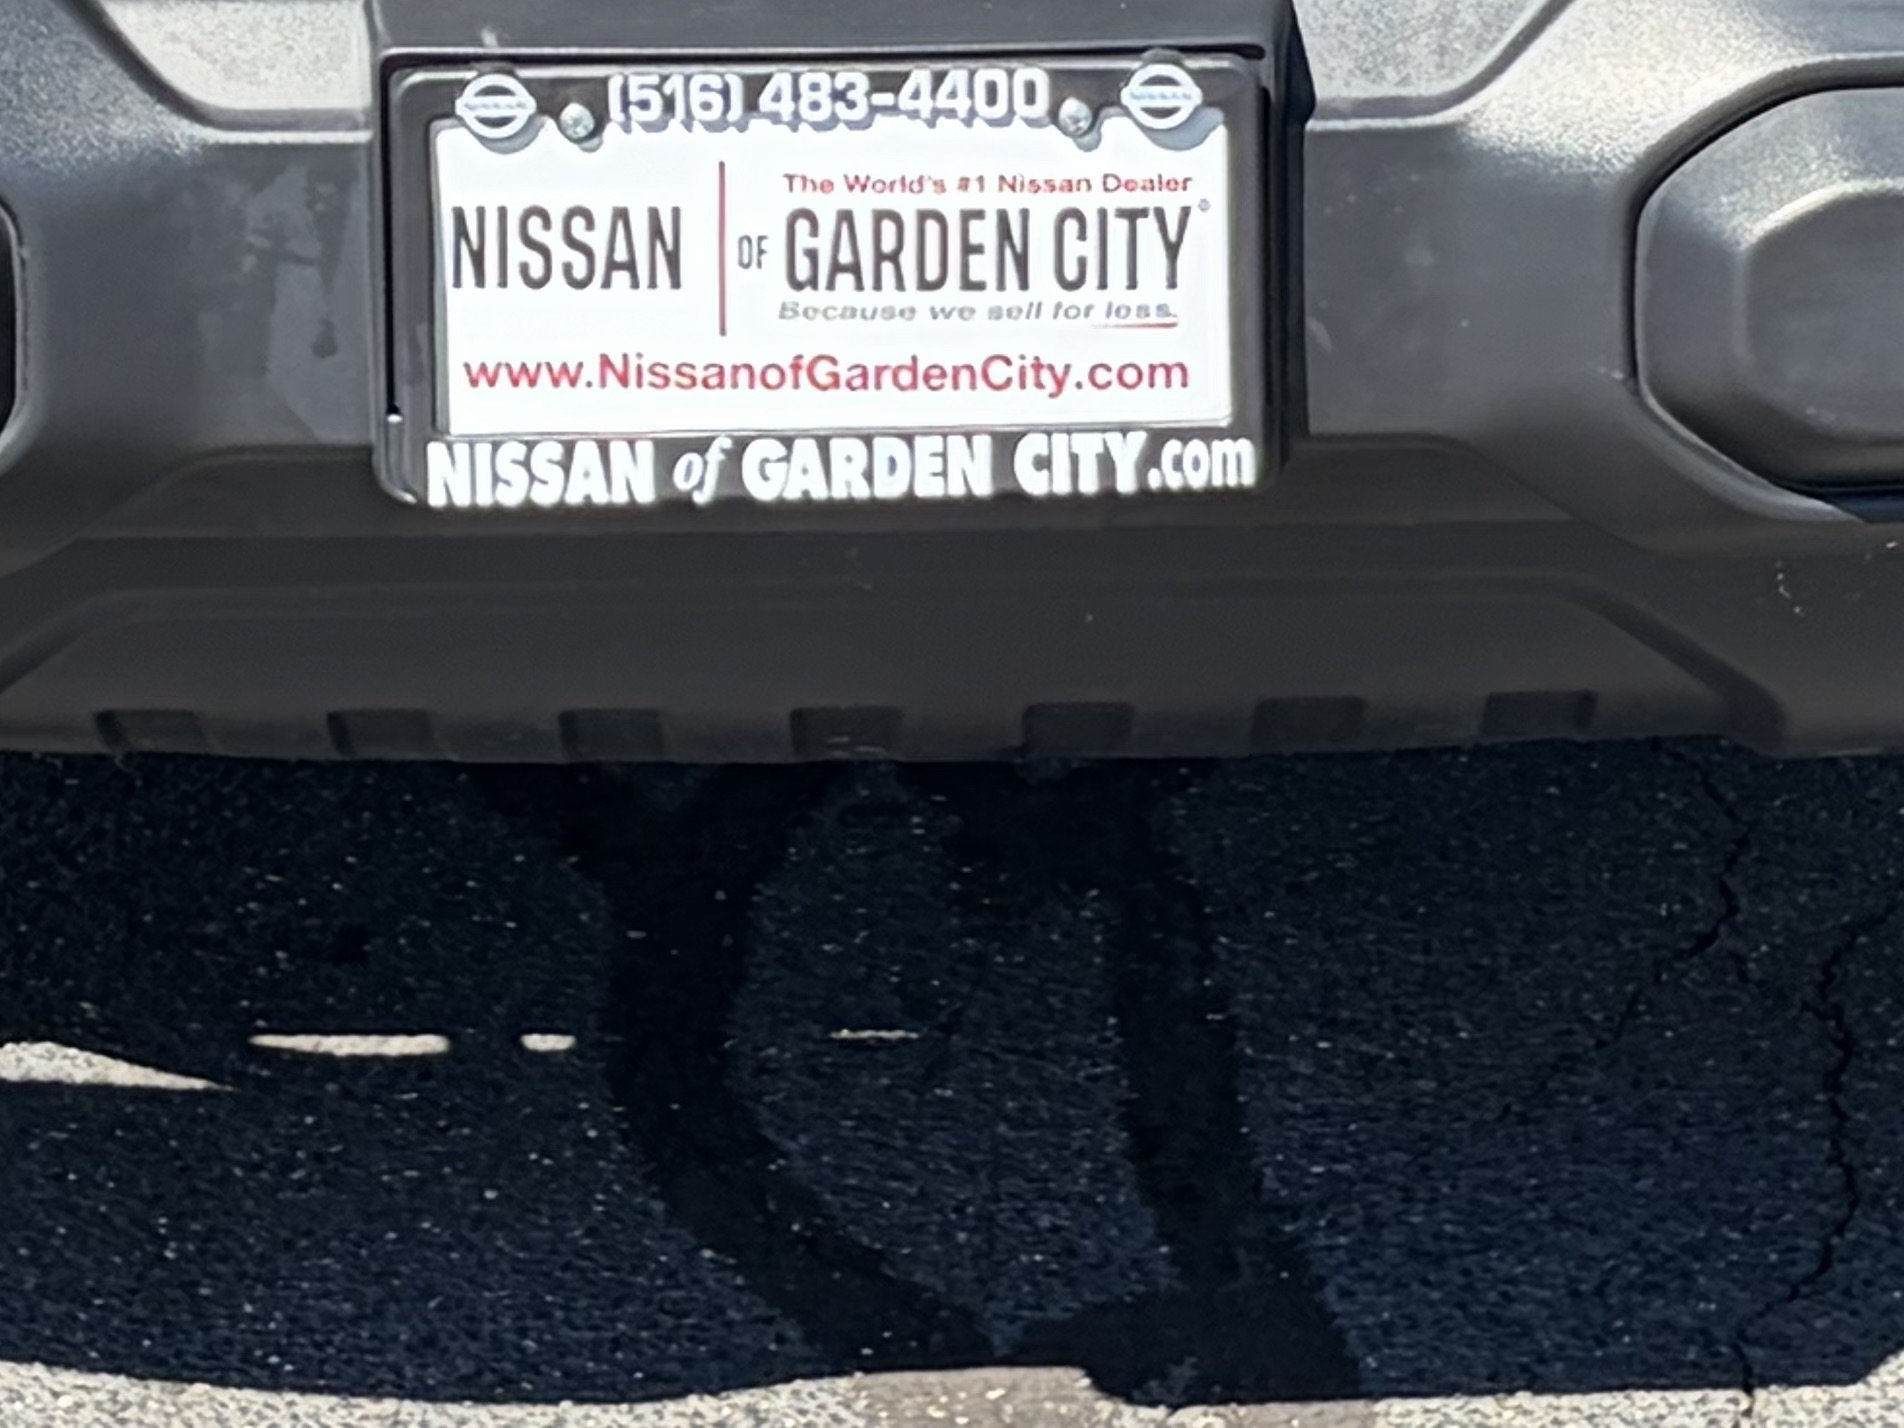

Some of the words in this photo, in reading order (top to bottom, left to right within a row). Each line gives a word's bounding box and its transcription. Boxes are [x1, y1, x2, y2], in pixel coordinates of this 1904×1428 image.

[607, 71, 745, 123] (516)
[758, 66, 1050, 123] 483-4400
[782, 172, 835, 195] The
[842, 173, 947, 195] World's
[956, 174, 986, 193] #1
[997, 173, 1093, 194] Nissan
[1101, 172, 1193, 194] Dealer
[451, 204, 682, 291] NISSAN
[737, 234, 769, 270] OF
[785, 207, 1031, 293] GARDEN
[1053, 205, 1192, 293] CITY
[778, 300, 918, 323] Because
[928, 304, 977, 322] we
[987, 300, 1044, 322] sell
[1052, 300, 1096, 321] for
[462, 351, 1190, 400] www.NissanofGardenCity.com
[426, 440, 656, 508] NISSAN
[672, 435, 734, 505] of
[741, 433, 994, 502] GARDEN
[1013, 430, 1257, 497] CITY.com
